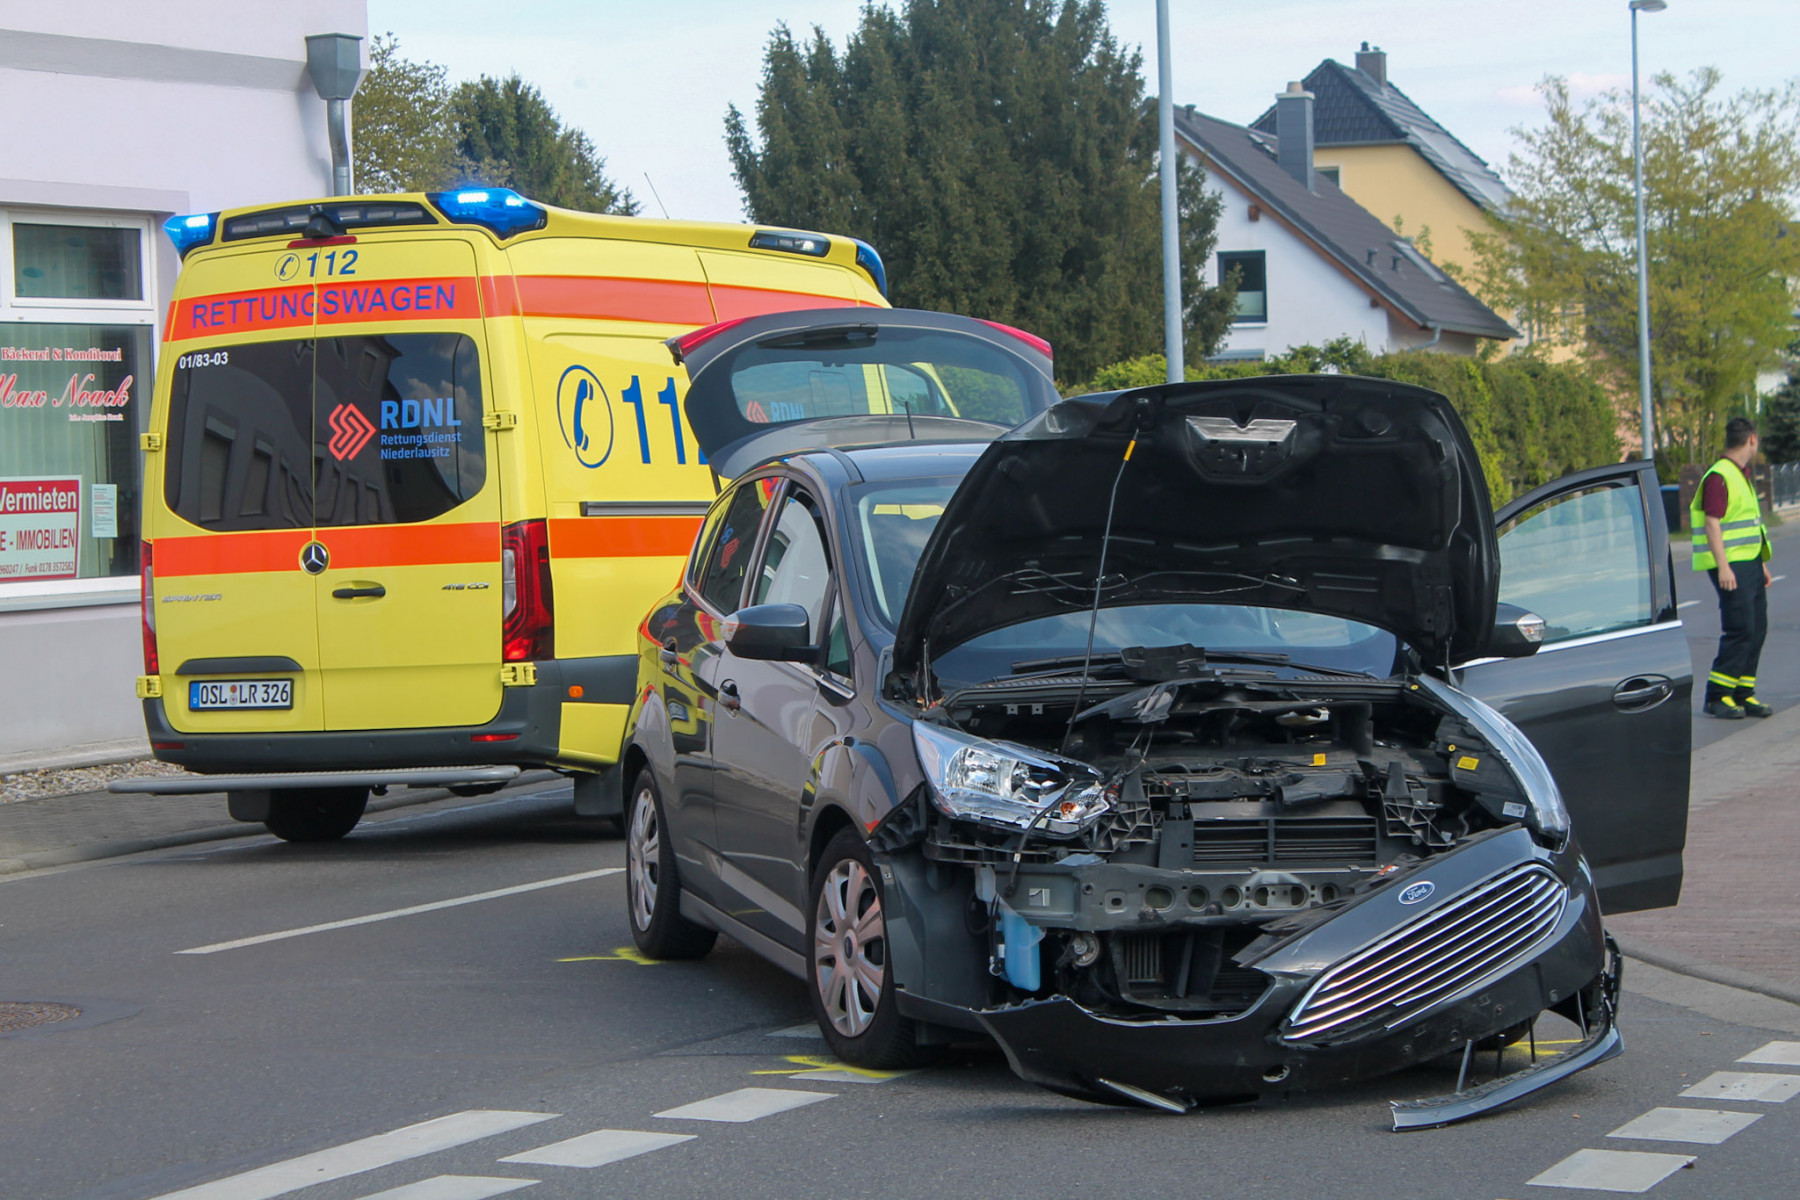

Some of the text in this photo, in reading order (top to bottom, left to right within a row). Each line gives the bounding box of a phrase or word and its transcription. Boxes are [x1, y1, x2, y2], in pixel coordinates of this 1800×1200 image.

[306, 249, 359, 278] 112
[191, 284, 456, 329] RETTUNGSWAGEN
[1, 346, 123, 361] Bäckerei & Konditorei
[178, 351, 229, 370] 01/83-03
[53, 373, 133, 407] Noack
[381, 397, 462, 430] RDNL
[621, 375, 710, 466] 11
[381, 431, 462, 447] Rettungsdienst
[381, 446, 450, 460] Niederlausitz
[16, 528, 75, 551] IMMOBILIEN
[200, 682, 290, 704] OSL LR 326
[1406, 885, 1428, 901] Ford
